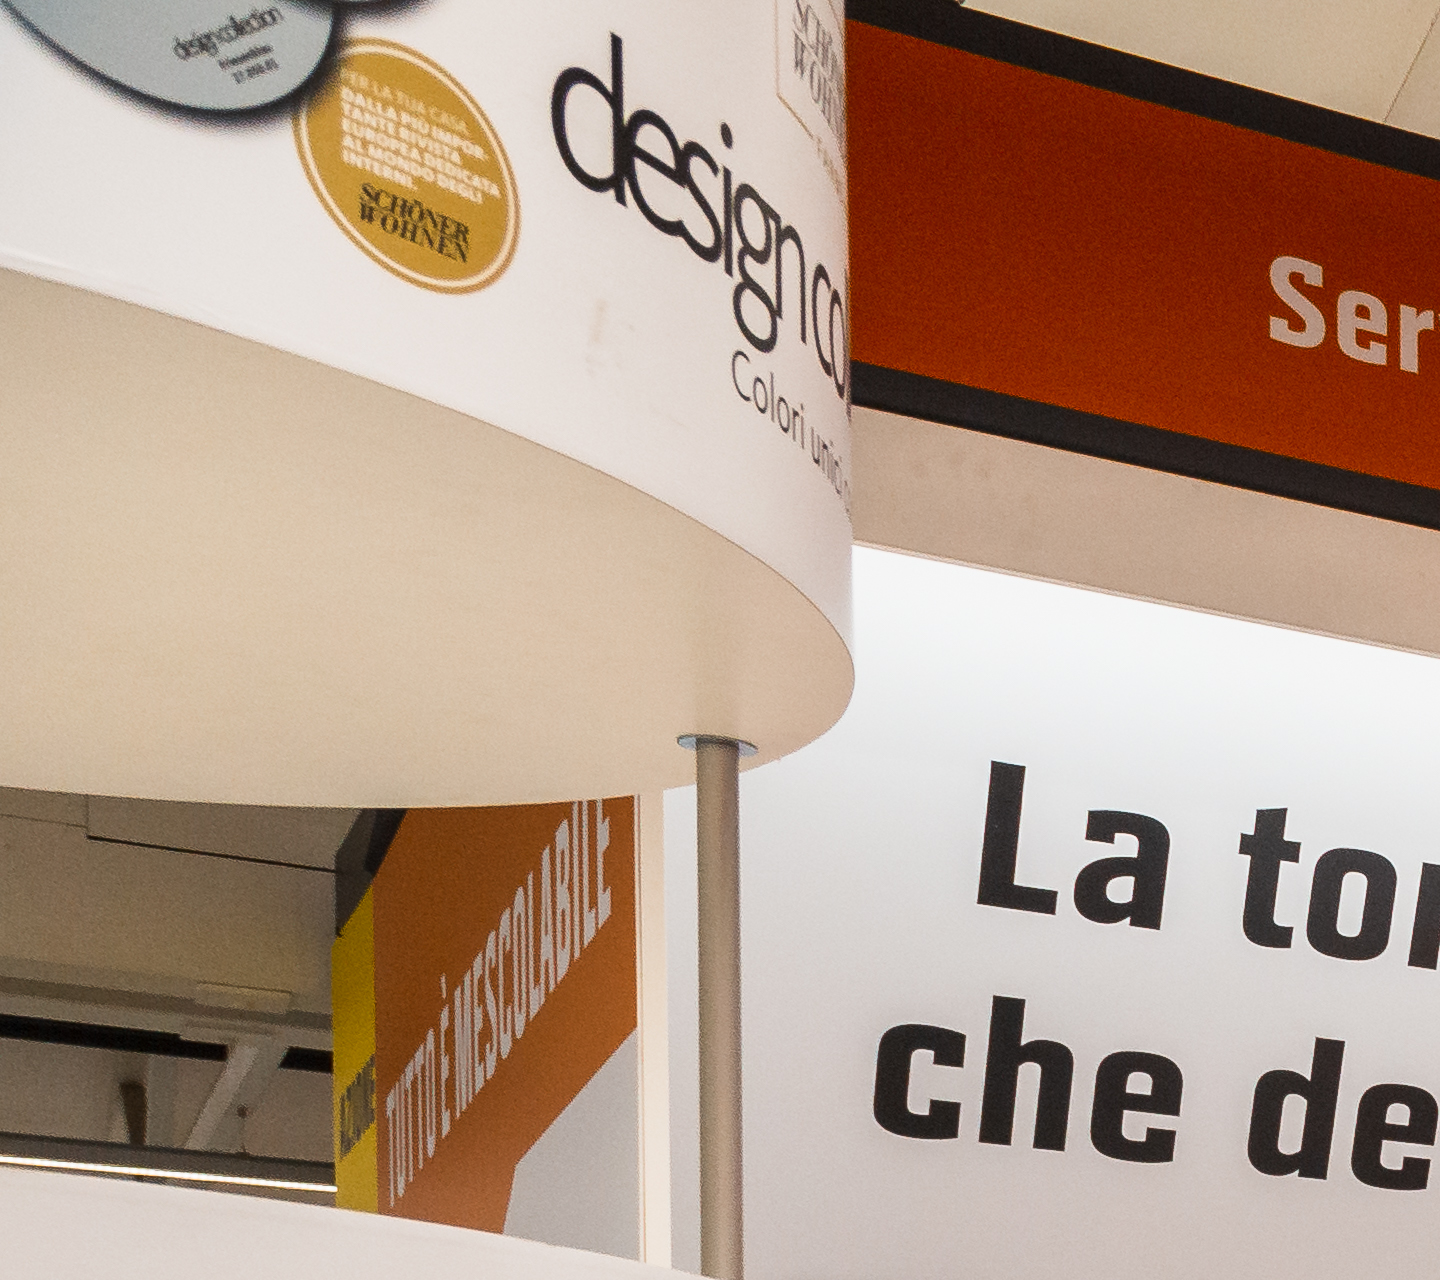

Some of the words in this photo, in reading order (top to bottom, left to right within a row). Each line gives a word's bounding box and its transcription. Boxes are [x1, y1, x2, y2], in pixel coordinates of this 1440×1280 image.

[551, 31, 807, 354] design
[732, 350, 804, 450] Colori
[976, 760, 1171, 931] La
[386, 1028, 439, 1208] TUTTO
[453, 799, 612, 1121] MESCOLABILE
[872, 994, 1185, 1164] che
